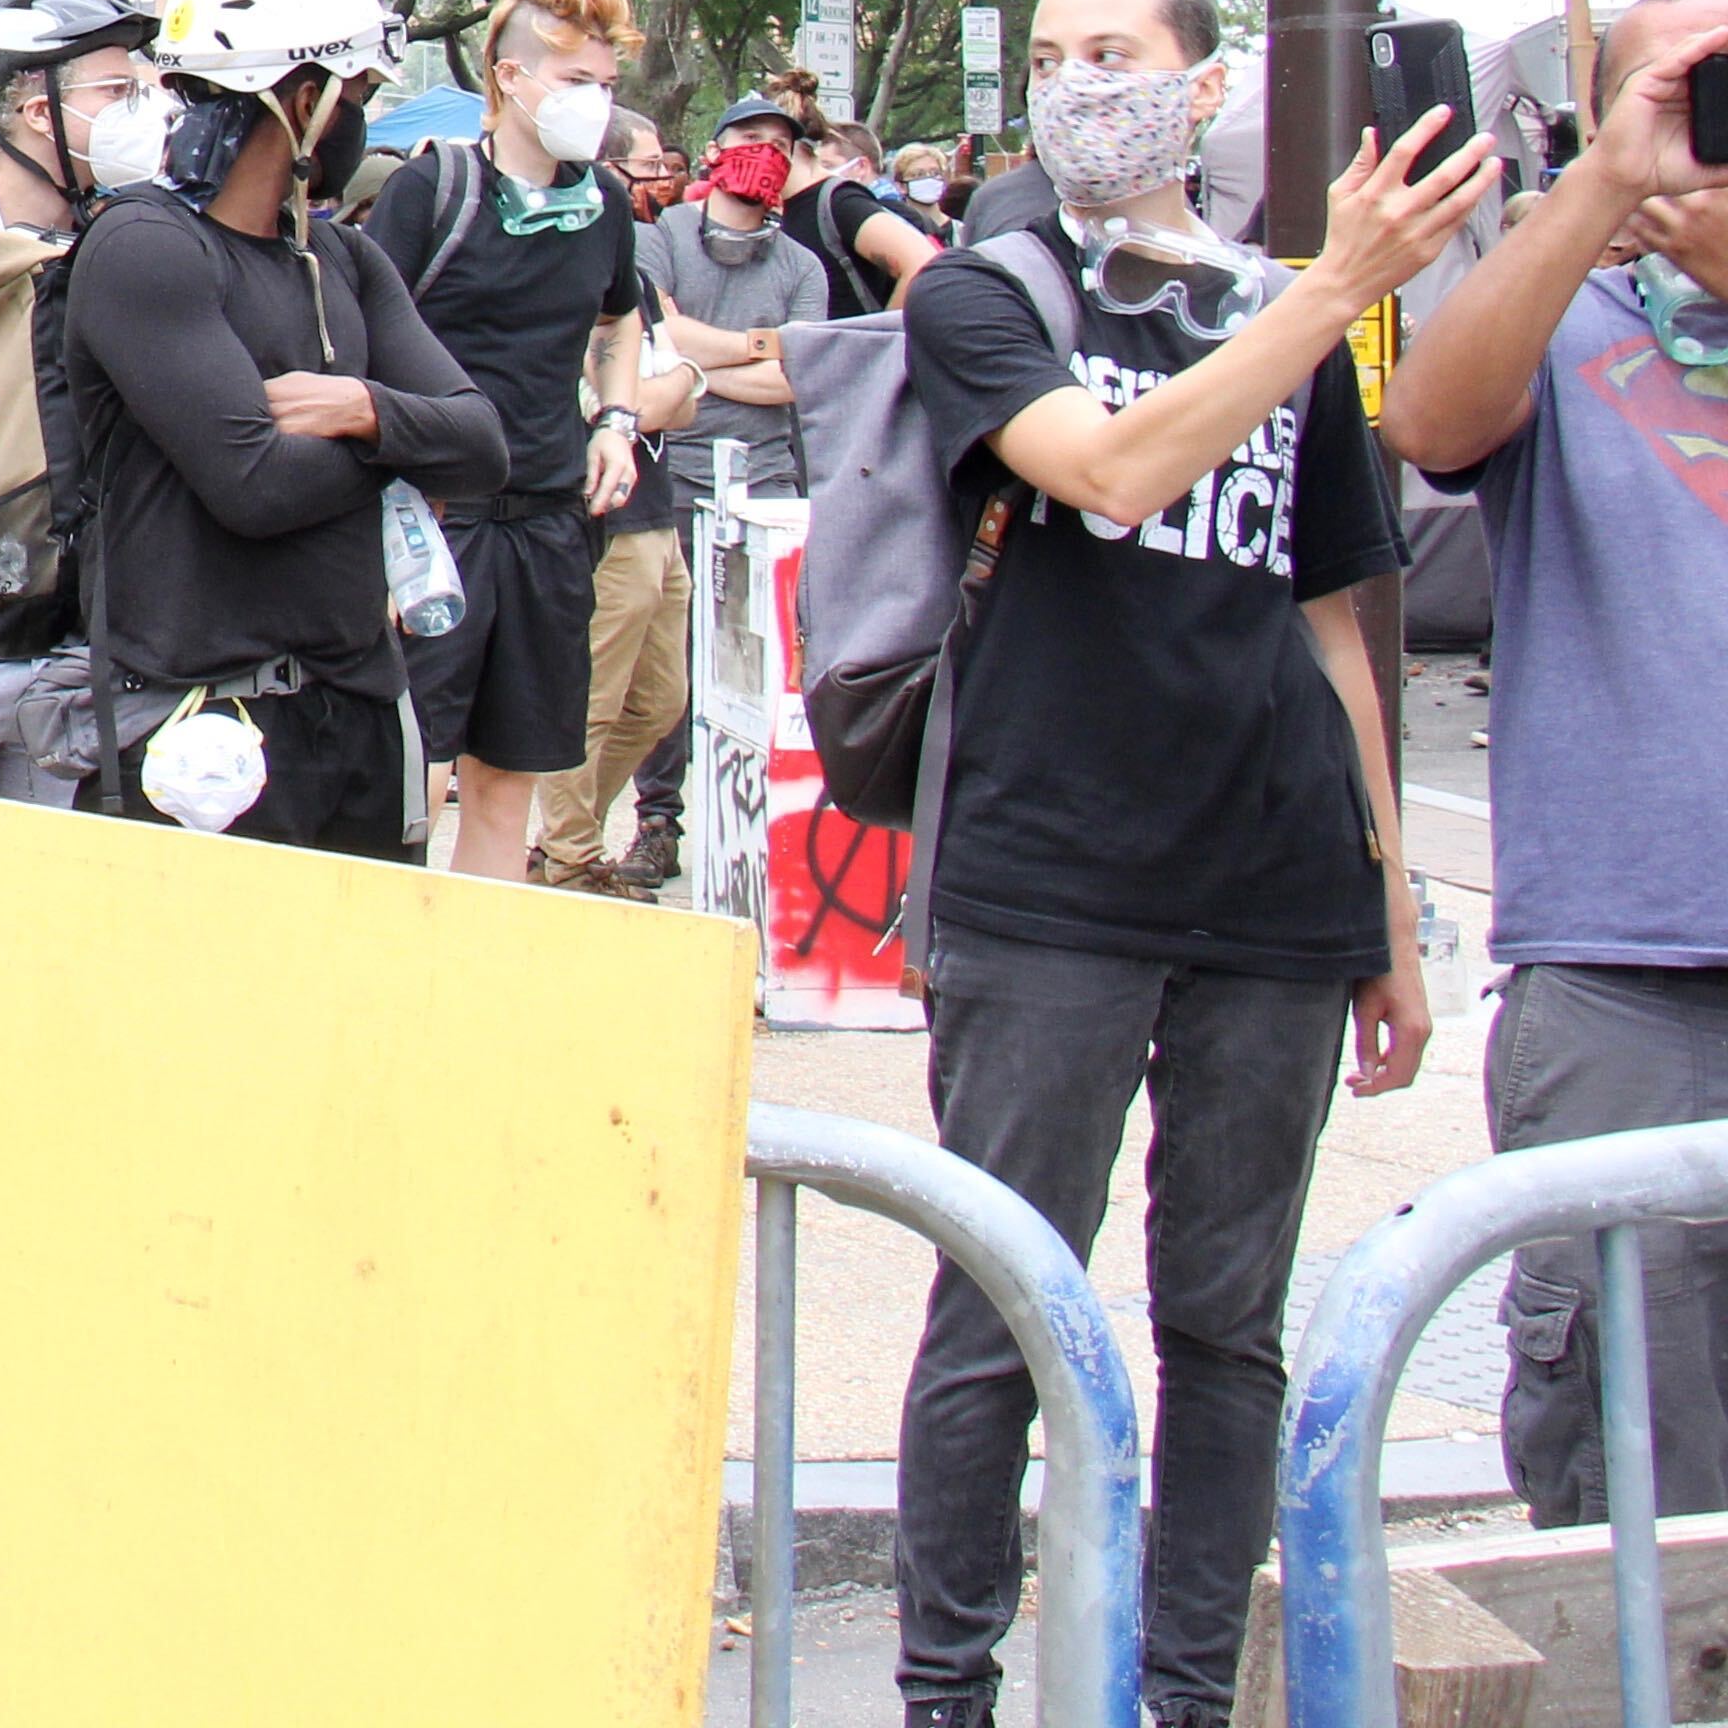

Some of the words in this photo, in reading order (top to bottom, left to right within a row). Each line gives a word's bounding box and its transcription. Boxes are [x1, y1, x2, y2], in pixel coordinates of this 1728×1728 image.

[819, 5, 850, 17] PARKING
[154, 51, 184, 67] vex
[287, 36, 355, 61] uvex
